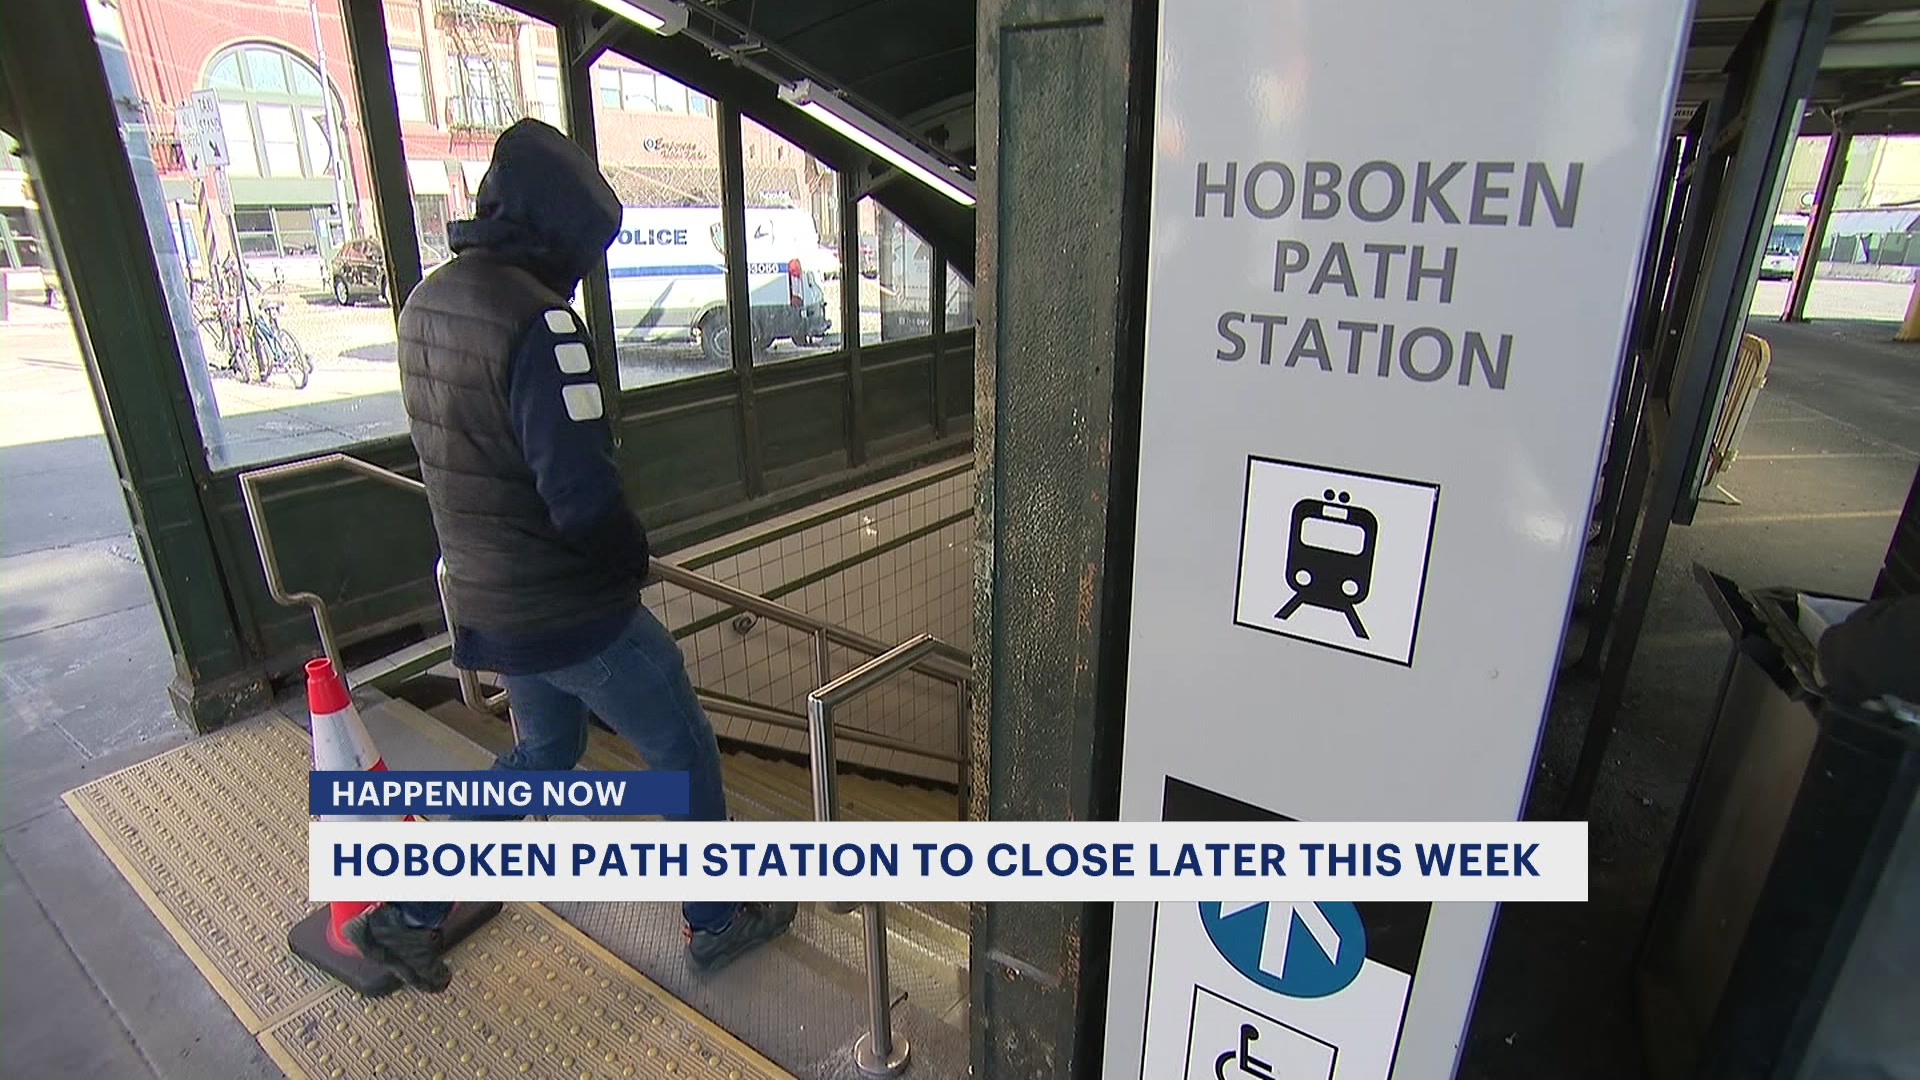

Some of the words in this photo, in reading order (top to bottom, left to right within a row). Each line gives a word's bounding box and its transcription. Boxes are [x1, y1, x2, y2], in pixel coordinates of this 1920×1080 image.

[1195, 161, 1584, 229] HOBOKEN
[617, 228, 688, 246] OLICE
[1274, 240, 1459, 304] PATH
[1216, 311, 1514, 391] STATION
